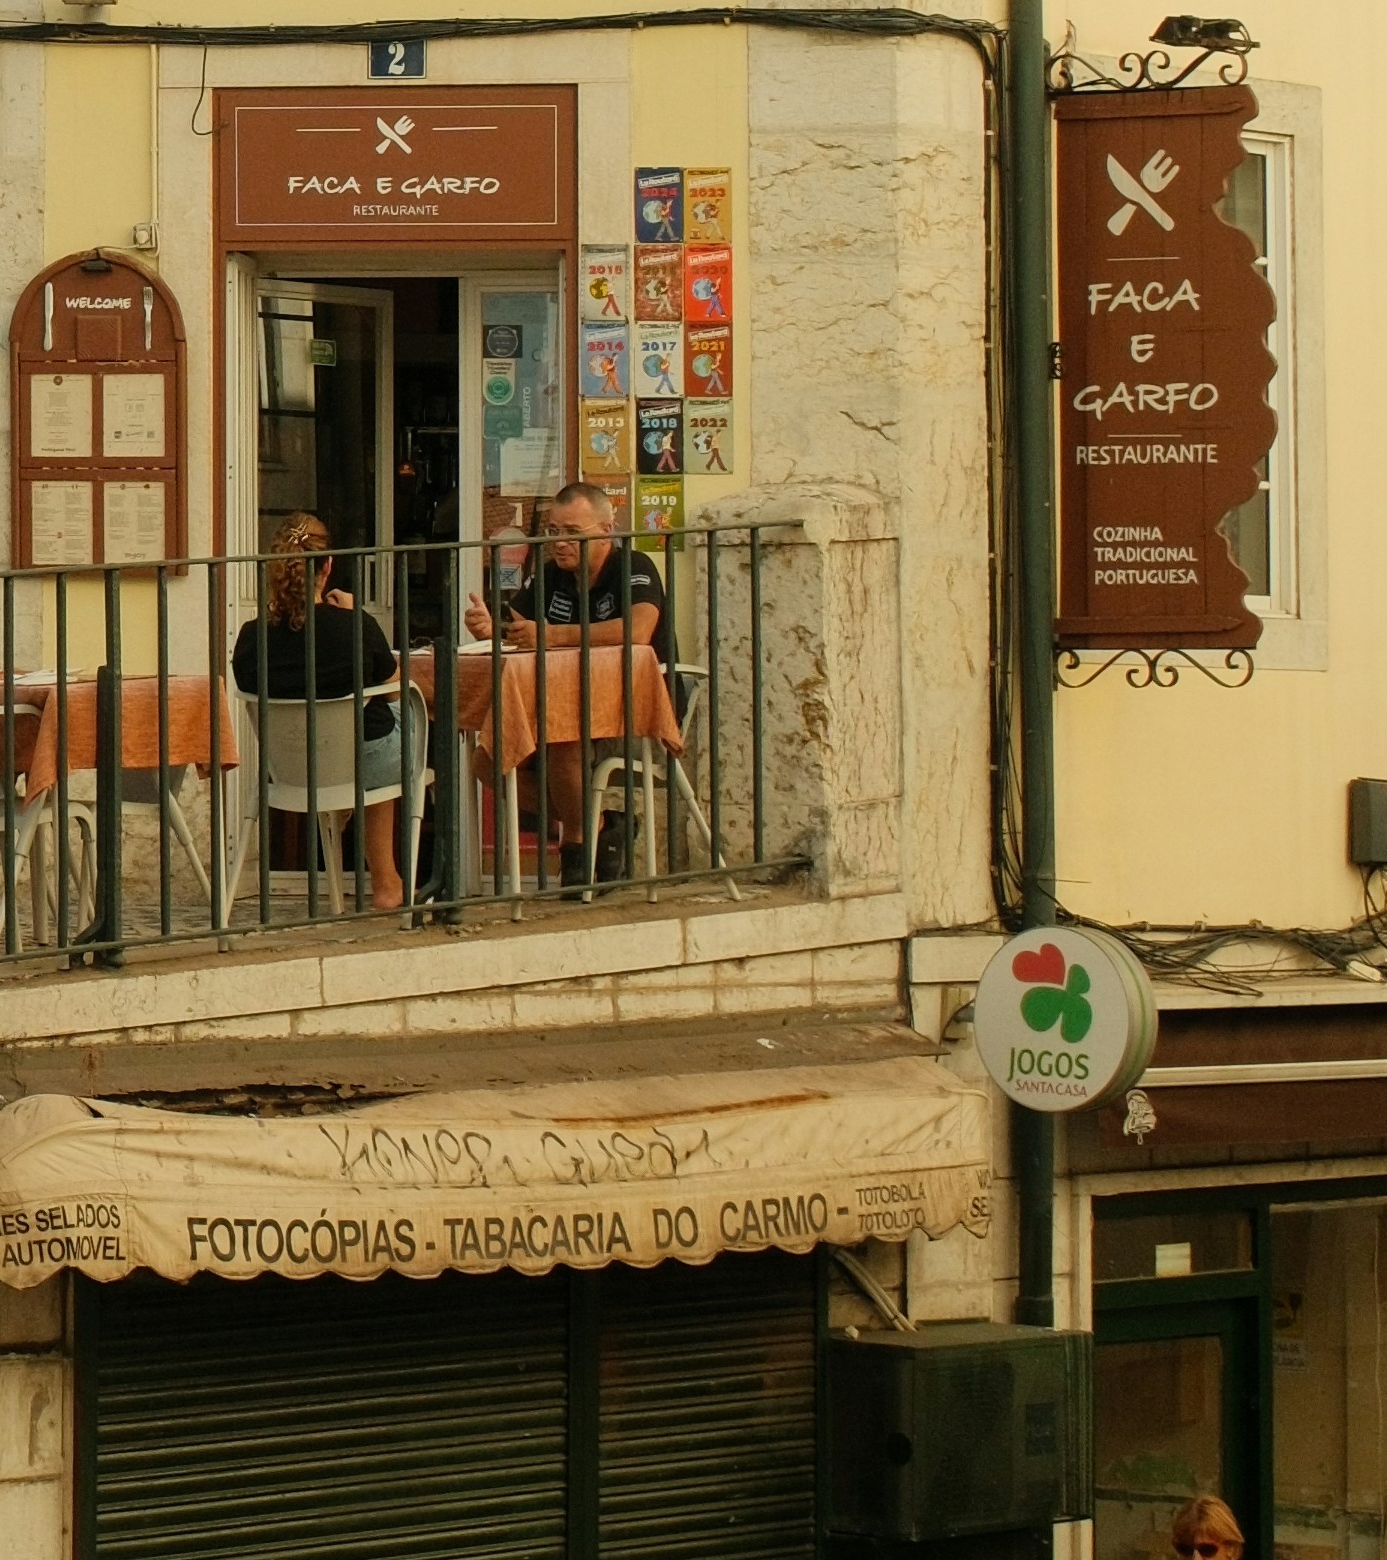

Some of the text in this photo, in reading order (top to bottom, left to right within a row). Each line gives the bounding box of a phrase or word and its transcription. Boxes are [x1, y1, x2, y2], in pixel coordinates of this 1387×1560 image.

[387, 41, 406, 75] 2
[288, 175, 500, 199] FACA E GARFO
[689, 188, 726, 197] 2023
[353, 204, 439, 216] RESTAURANTE
[691, 265, 728, 275] 2020
[65, 296, 132, 310] WELCOME
[1088, 278, 1200, 316] FACA
[587, 342, 625, 351] 2014
[641, 342, 677, 351] 2017
[691, 341, 725, 351] 2021
[1130, 334, 1155, 363] E
[1073, 381, 1219, 422] GARFO
[587, 418, 624, 428] 2013
[641, 418, 677, 428] 2018
[690, 418, 727, 428] 2022
[1076, 444, 1219, 466] RESTAURANTE
[641, 495, 677, 506] 2019
[1093, 526, 1163, 543] COZINHA
[1093, 547, 1198, 562] TRADICIONAL
[1094, 569, 1198, 585] PORTUGUESA
[1007, 1046, 1090, 1081] JOGOS
[856, 1182, 927, 1206] TOTOBOLA
[34, 1203, 122, 1232] SELADOS
[858, 1207, 926, 1231] TOTOLOTO
[187, 1208, 417, 1264] FOTOCÓPIAS
[443, 1211, 632, 1260] TABACARIA
[652, 1205, 699, 1248] DO
[720, 1192, 828, 1242] CARMO
